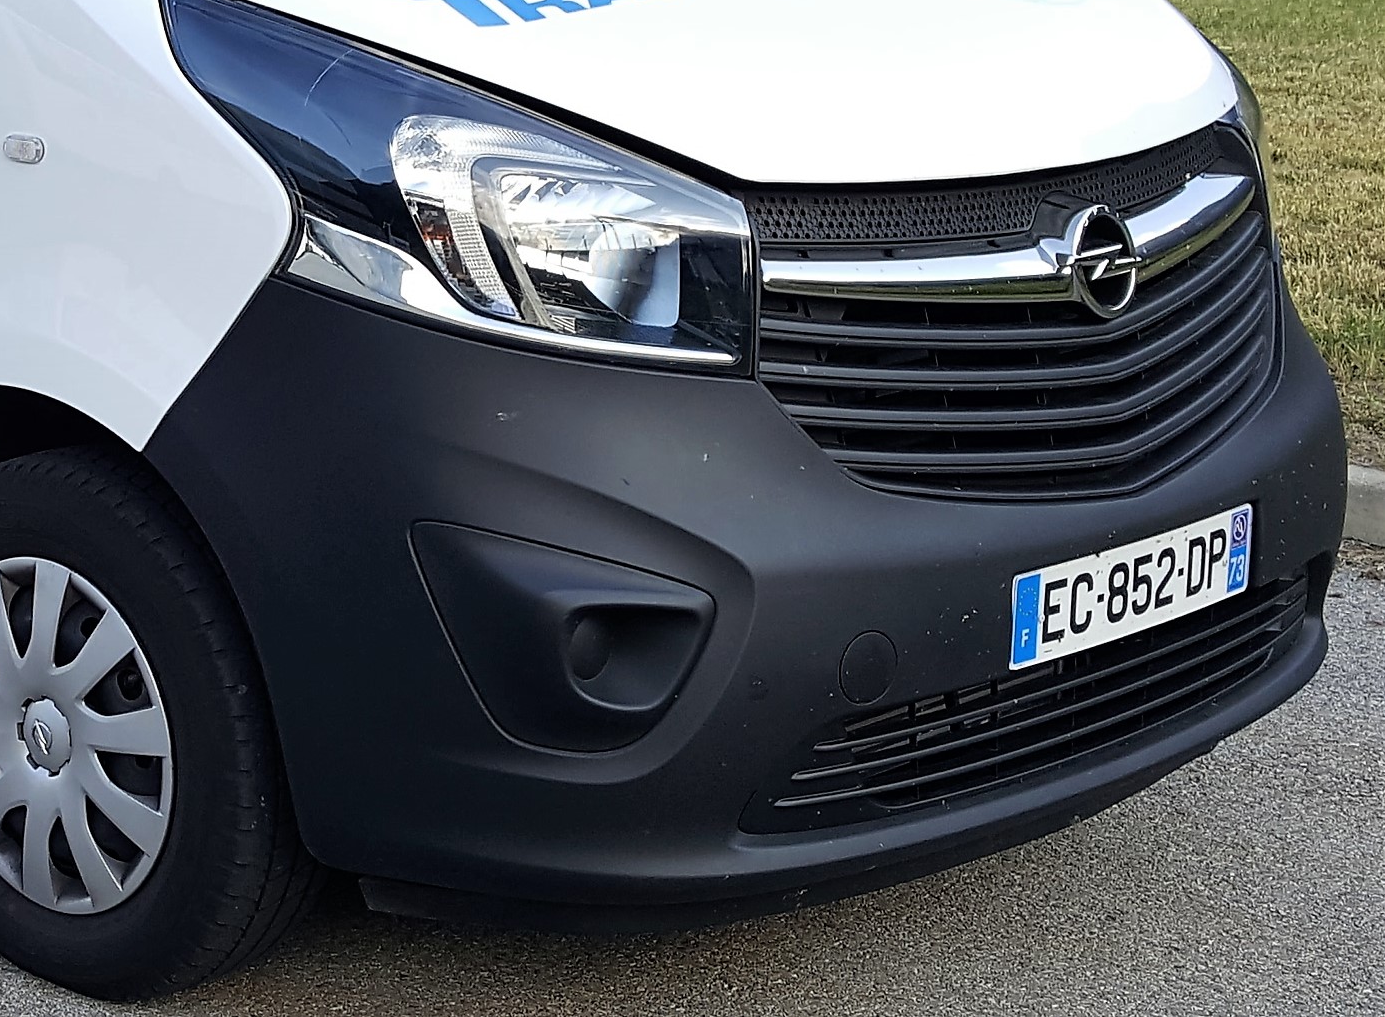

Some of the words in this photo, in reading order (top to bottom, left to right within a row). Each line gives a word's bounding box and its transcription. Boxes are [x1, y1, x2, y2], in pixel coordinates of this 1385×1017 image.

[1041, 528, 1227, 644] EC-852-DP
[1228, 554, 1246, 587] 73
[1020, 628, 1030, 648] F
